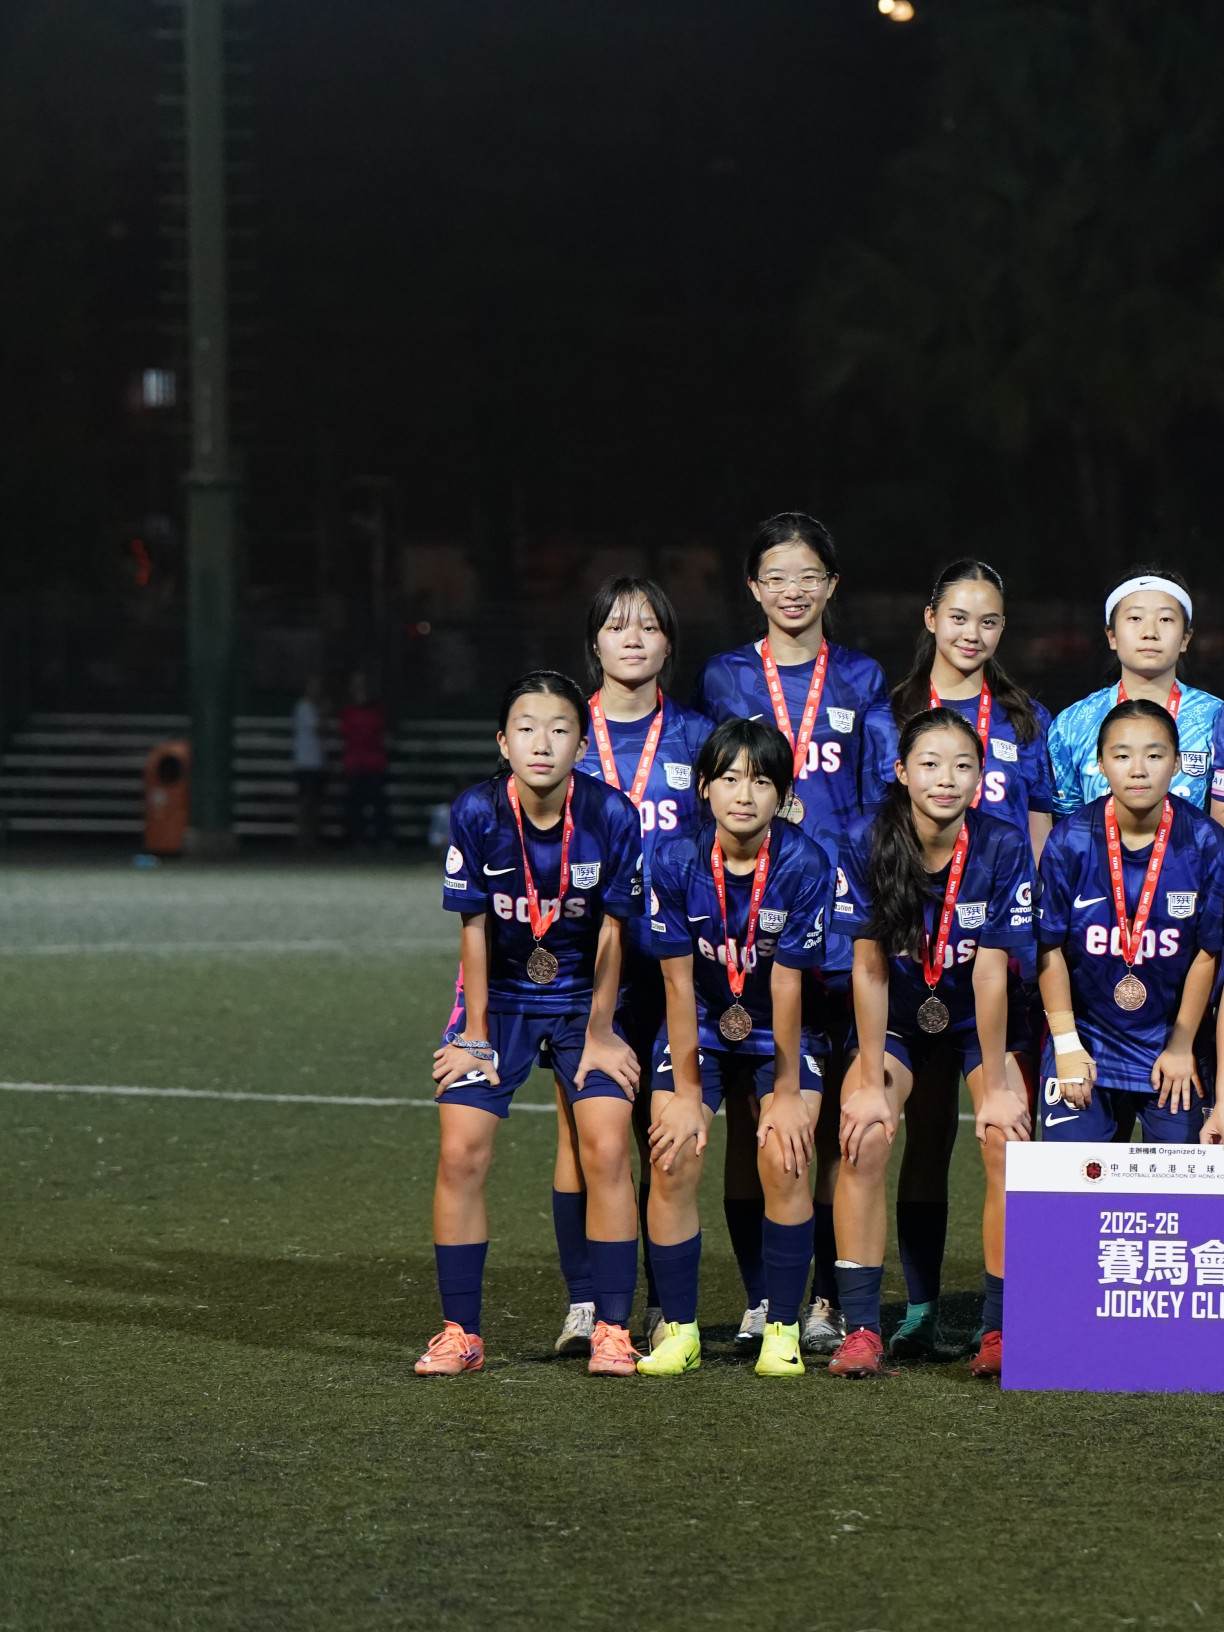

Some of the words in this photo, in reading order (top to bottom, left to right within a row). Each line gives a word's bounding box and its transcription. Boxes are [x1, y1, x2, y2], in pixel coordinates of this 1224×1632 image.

[1158, 1147, 1195, 1156] Organized
[1198, 1148, 1206, 1156] by
[1100, 1212, 1179, 1234] 2025-26
[1096, 1290, 1184, 1318] JOCKEY
